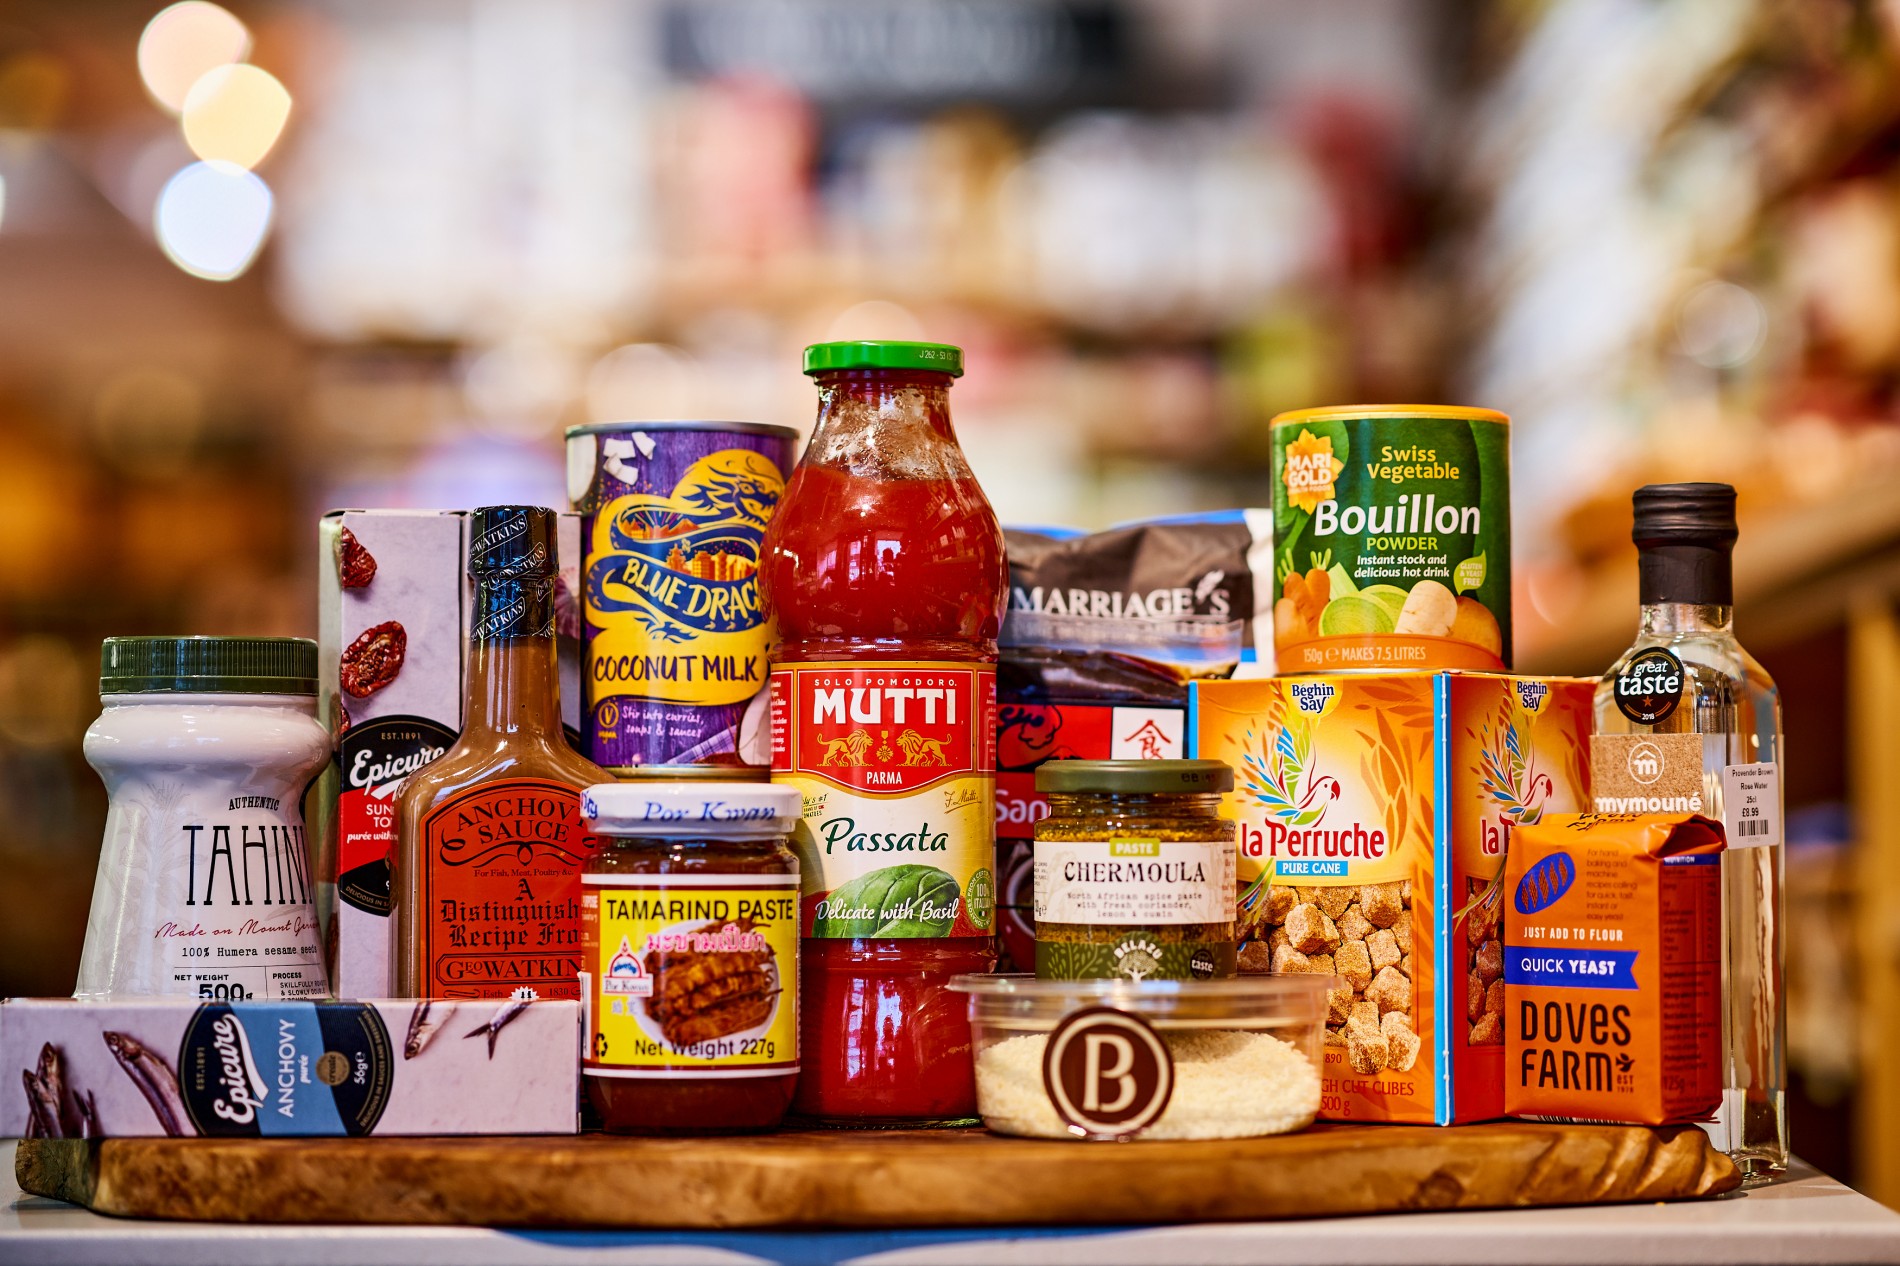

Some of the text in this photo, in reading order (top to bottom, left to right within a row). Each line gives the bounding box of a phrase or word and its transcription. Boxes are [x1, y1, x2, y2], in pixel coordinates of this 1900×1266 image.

[1288, 452, 1331, 471] MARI
[1381, 445, 1436, 462] Swiss
[1288, 469, 1332, 487] GOLD
[1366, 462, 1460, 484] Vegetable
[1313, 494, 1480, 536] Bouillon
[1366, 537, 1438, 551] POWDER
[1357, 554, 1447, 566] Instant stock and
[1354, 566, 1450, 578] delicious hot drink
[621, 558, 687, 613] BLUE
[1464, 578, 1480, 586] FREE
[1303, 646, 1426, 663] 150g MAKES 7.5 LITRES
[594, 655, 759, 682] COCONUT MILK
[1634, 660, 1668, 679] great
[814, 678, 852, 686] SOLO
[1516, 681, 1548, 698] Béghin
[1291, 683, 1335, 699] Béghin
[813, 688, 956, 725] MUTTI
[1300, 696, 1328, 714] Say
[1522, 694, 1544, 712] Say
[622, 706, 640, 718] Stir
[642, 709, 663, 720] into
[626, 723, 702, 738] soups & sauces
[866, 772, 902, 784] PARMA
[1732, 768, 1774, 777] Provender Brown
[1740, 782, 1768, 790] Rose Water
[228, 796, 280, 811] AUTHENTIC
[1595, 792, 1702, 814] mymouné
[1746, 796, 1757, 804] 25cl
[643, 801, 776, 822] Por Kwan
[1742, 807, 1760, 818] £8.99
[347, 832, 372, 844] purée
[478, 820, 570, 844] SAUCE
[820, 817, 949, 855] Passata
[1242, 823, 1262, 857] la
[1264, 818, 1385, 859] Perruche
[1482, 818, 1499, 857] la
[1115, 843, 1155, 854] PASTE
[1587, 848, 1597, 856] For
[1064, 861, 1206, 883] CHERMOULA
[1282, 863, 1341, 874] PURE CANE
[1586, 860, 1612, 868] baking
[474, 870, 488, 878] For
[490, 870, 510, 879] Fish,
[511, 868, 532, 878] Meat,
[533, 868, 560, 879] Poultry
[1586, 870, 1618, 878] machine
[514, 878, 536, 902] A
[1067, 892, 1203, 902] North African spice paste
[607, 898, 794, 920] TAMARIND PASTE
[815, 898, 960, 922] Delicate with Basil
[1097, 910, 1126, 918] lemon
[1103, 901, 1132, 909] fresh
[1138, 902, 1192, 910] coriander,
[155, 922, 207, 938] Made
[238, 918, 293, 936] Mount
[448, 922, 579, 951] Recipe Fro
[1524, 926, 1624, 942] JUST ADD TO FLOUR
[182, 946, 210, 958] 100%
[217, 946, 258, 957] Humera
[264, 946, 298, 956] sesame
[1191, 959, 1214, 972] taste
[1520, 958, 1616, 976] QUICK YEAST
[548, 988, 568, 996] 1830
[635, 1038, 775, 1060] Net Weight 227g
[213, 1014, 268, 1124] Epicure
[278, 1018, 296, 1118] ANCHOVY
[298, 1054, 312, 1085] purée
[1082, 1033, 1138, 1113] B
[1342, 1080, 1414, 1096] CUT CUBES
[1321, 1096, 1351, 1117] 500 g
